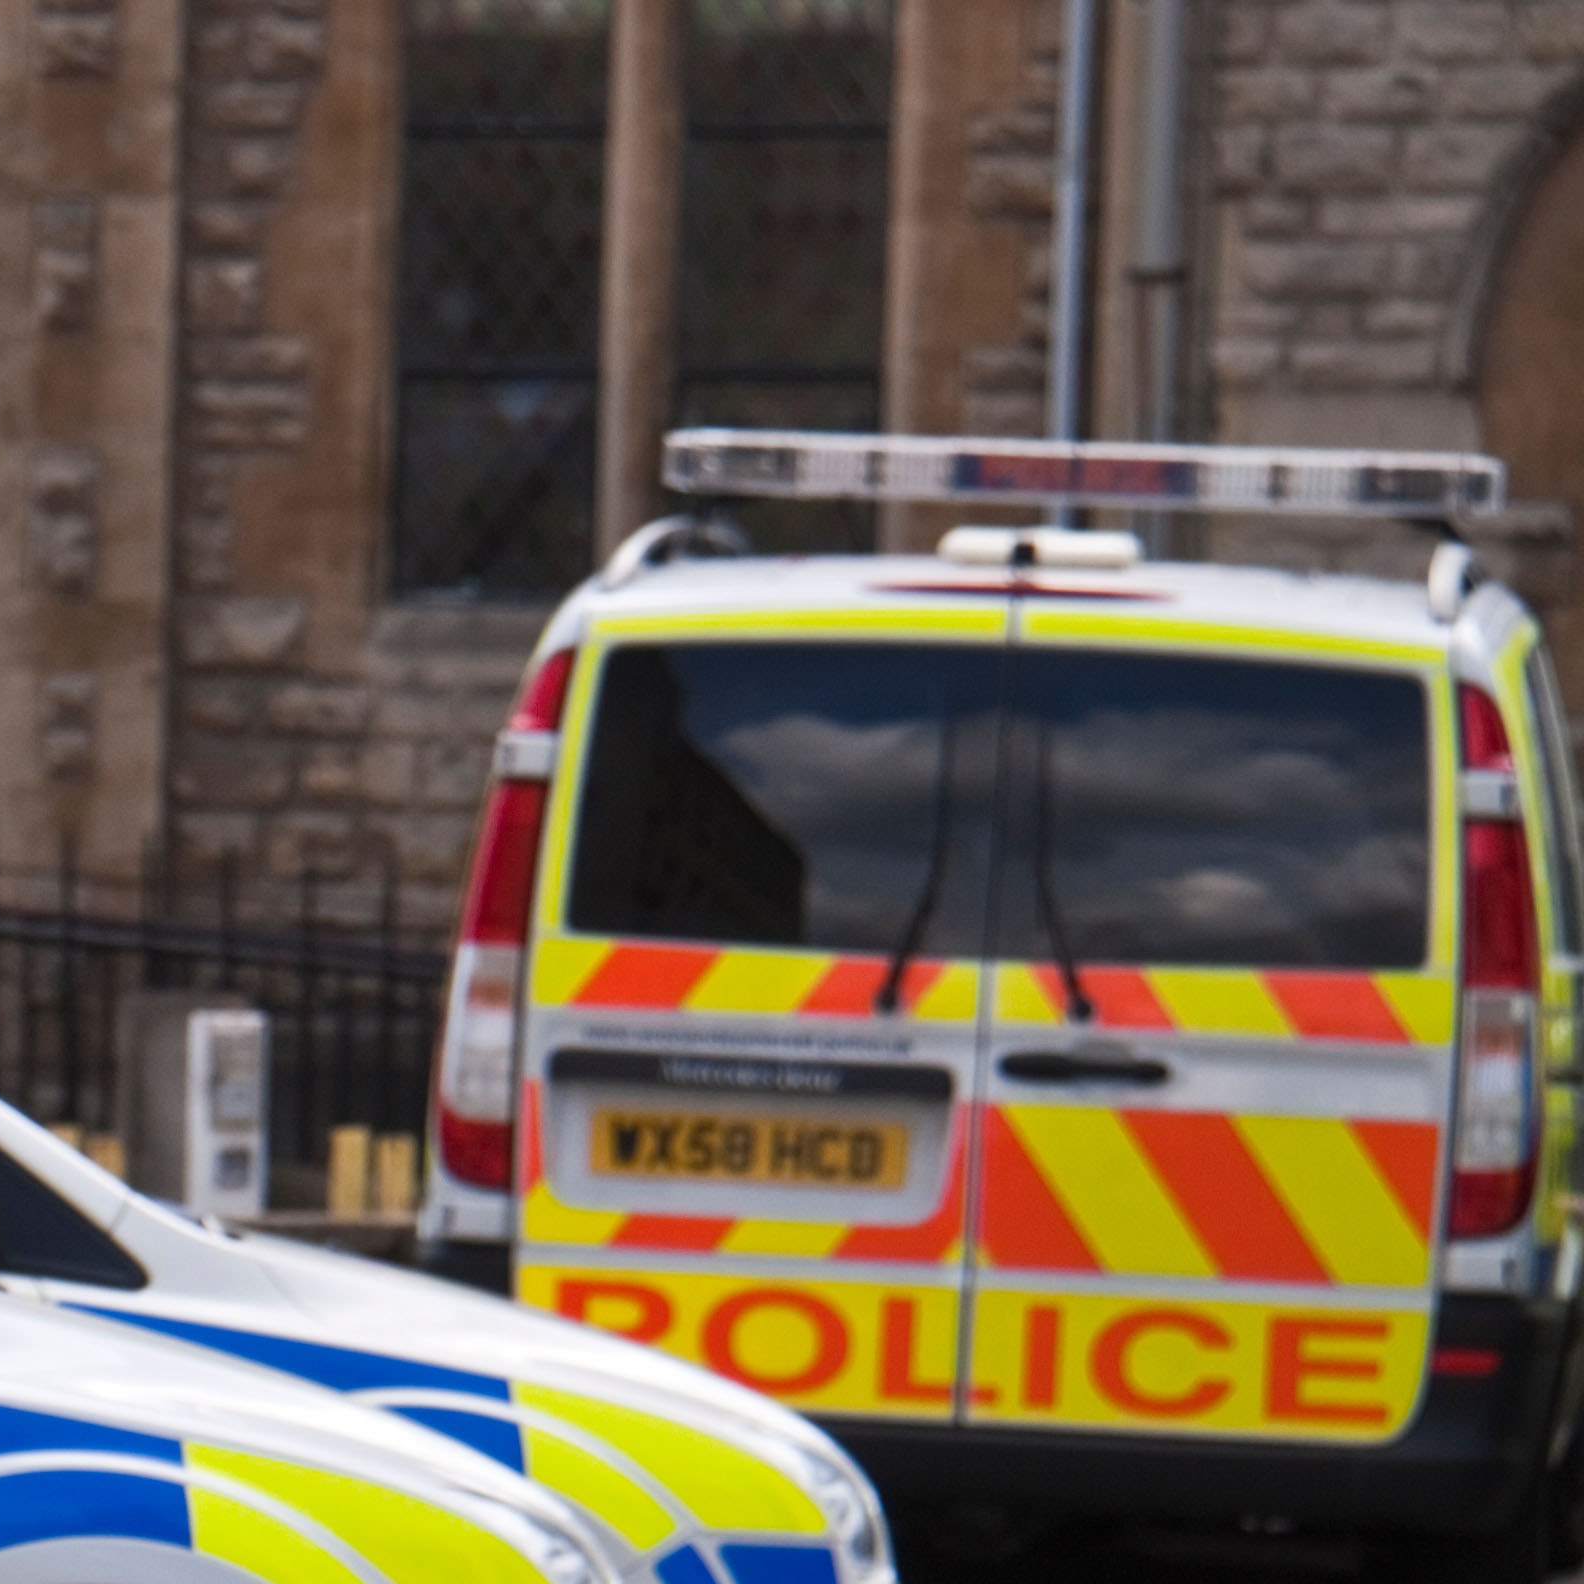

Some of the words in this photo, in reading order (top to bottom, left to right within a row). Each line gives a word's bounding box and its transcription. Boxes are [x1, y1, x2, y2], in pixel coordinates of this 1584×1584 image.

[610, 1115, 756, 1174] WX58
[770, 1120, 883, 1182] HCD
[554, 1278, 1393, 1426] POLICE
